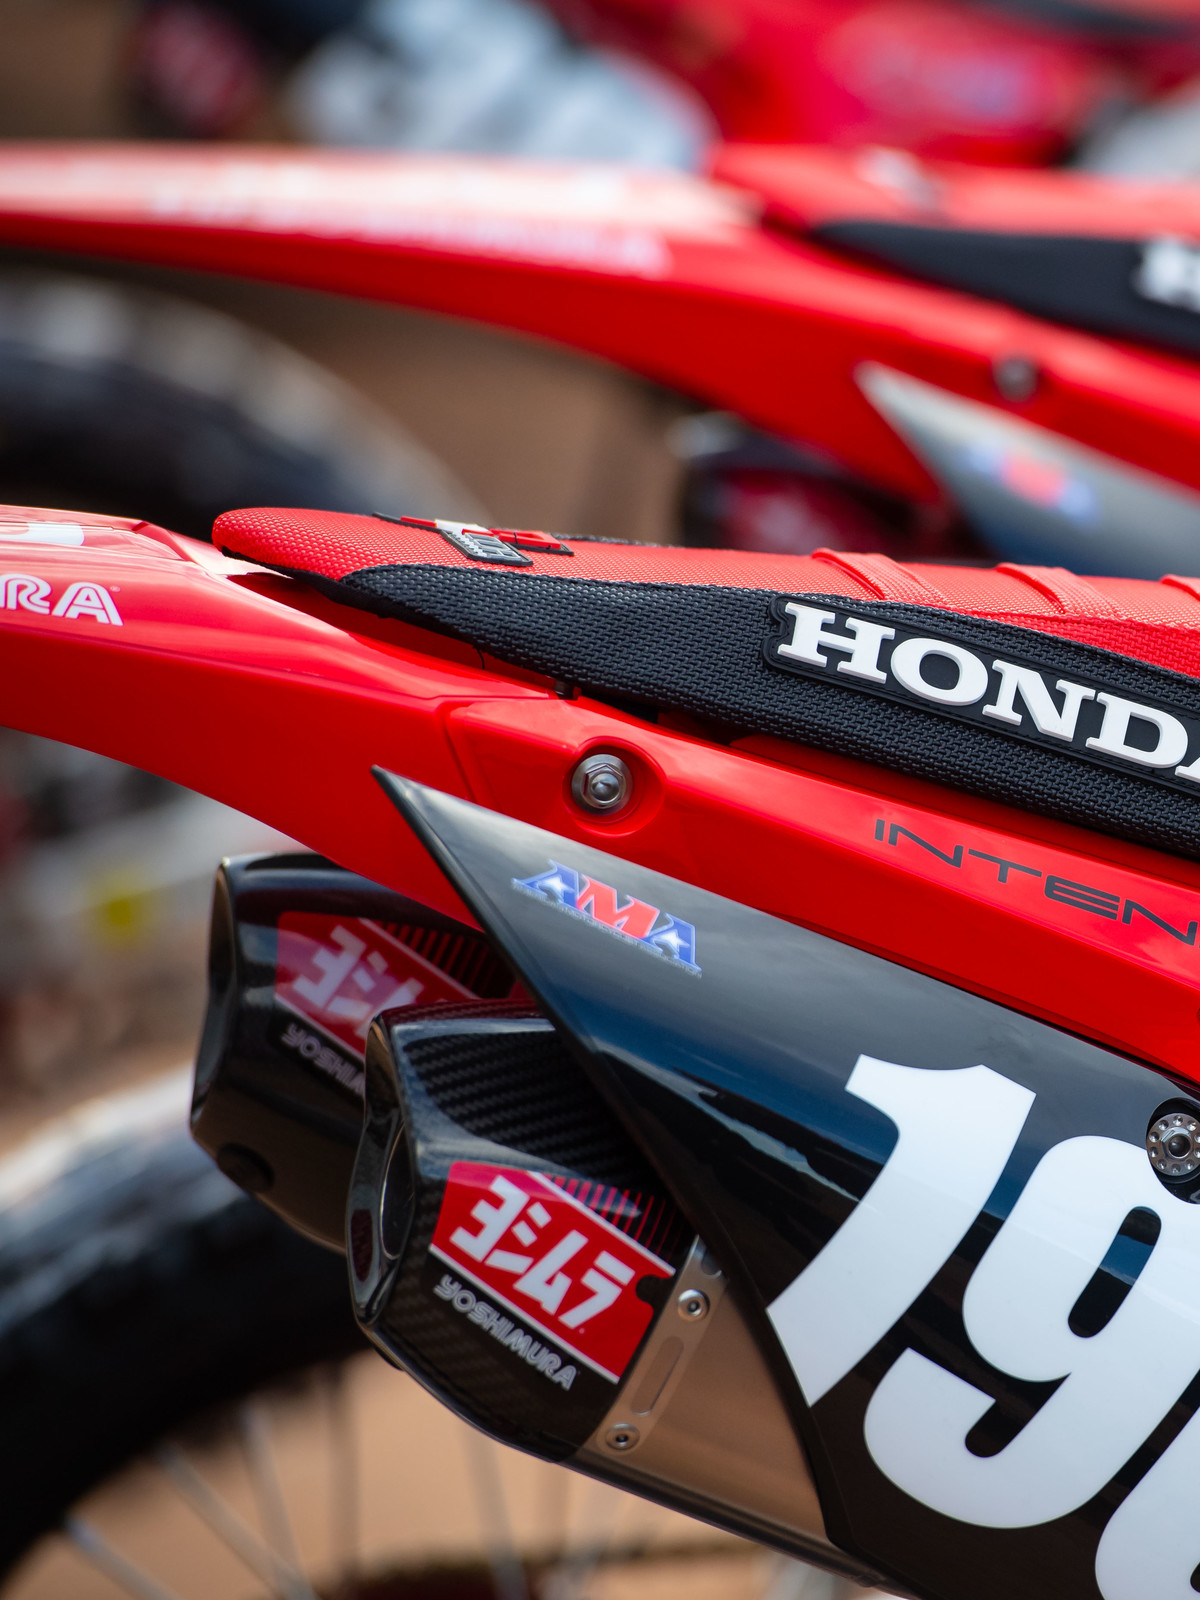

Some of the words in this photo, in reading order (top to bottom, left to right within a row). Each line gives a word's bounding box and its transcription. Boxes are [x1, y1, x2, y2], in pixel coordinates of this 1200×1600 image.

[510, 859, 702, 972] AMA
[449, 1174, 636, 1330] ヨシムラ
[433, 1274, 577, 1391] YOSHIMURA
